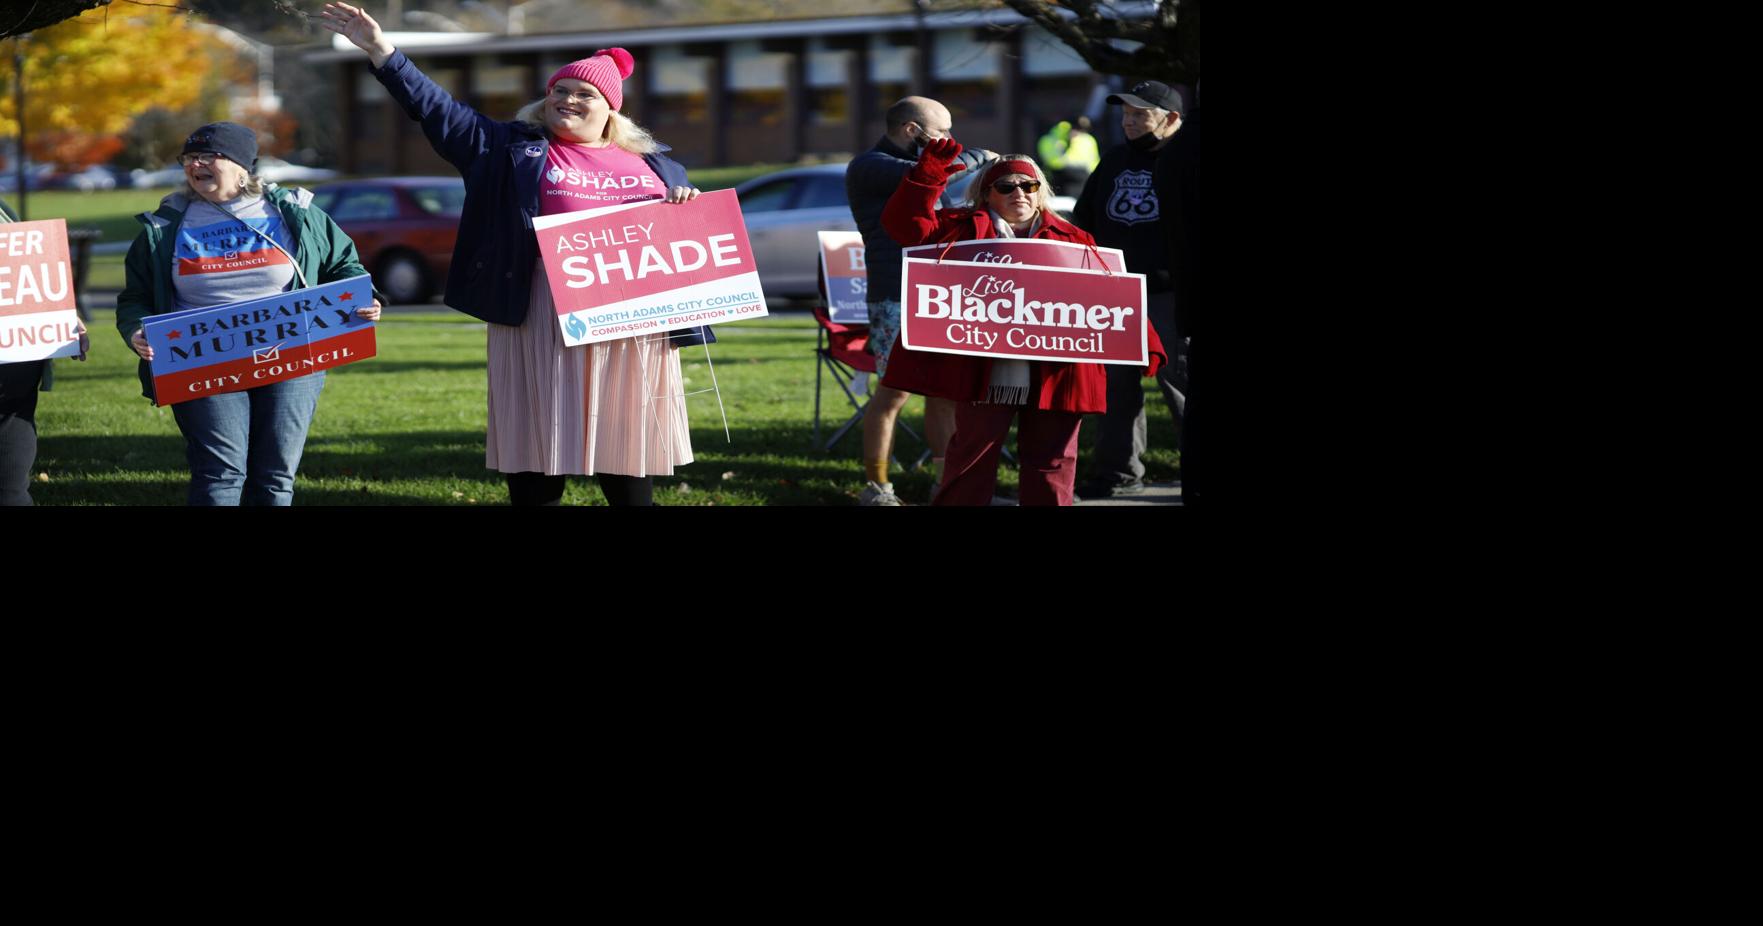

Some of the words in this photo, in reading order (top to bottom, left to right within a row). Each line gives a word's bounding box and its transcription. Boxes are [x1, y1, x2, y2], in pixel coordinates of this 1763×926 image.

[566, 174, 655, 189] SHADE
[568, 167, 614, 178] ASHLEY
[546, 189, 573, 197] NORTH
[574, 192, 601, 201] ADAMS
[1115, 189, 1154, 215] 66
[202, 224, 251, 239] BARBAR
[556, 222, 654, 254] ASHLEY
[226, 257, 268, 268] COUNCIL
[562, 233, 741, 288] SHADE
[963, 274, 1015, 298] Lisa
[190, 295, 333, 337] BARBARA
[588, 311, 630, 325] NORTH
[633, 304, 675, 318] ADAMS
[677, 299, 703, 311] CITY
[706, 291, 759, 306] COUNCIL
[591, 320, 657, 337] COMPASSION
[667, 309, 726, 325] EDUCATION
[736, 304, 762, 314] LOVE
[914, 283, 1134, 331] Blackmer
[168, 304, 358, 363] MURRAY
[946, 323, 998, 350] City
[1006, 327, 1104, 353] Council
[188, 373, 243, 393] CITY
[253, 347, 354, 380] COUNCIL
